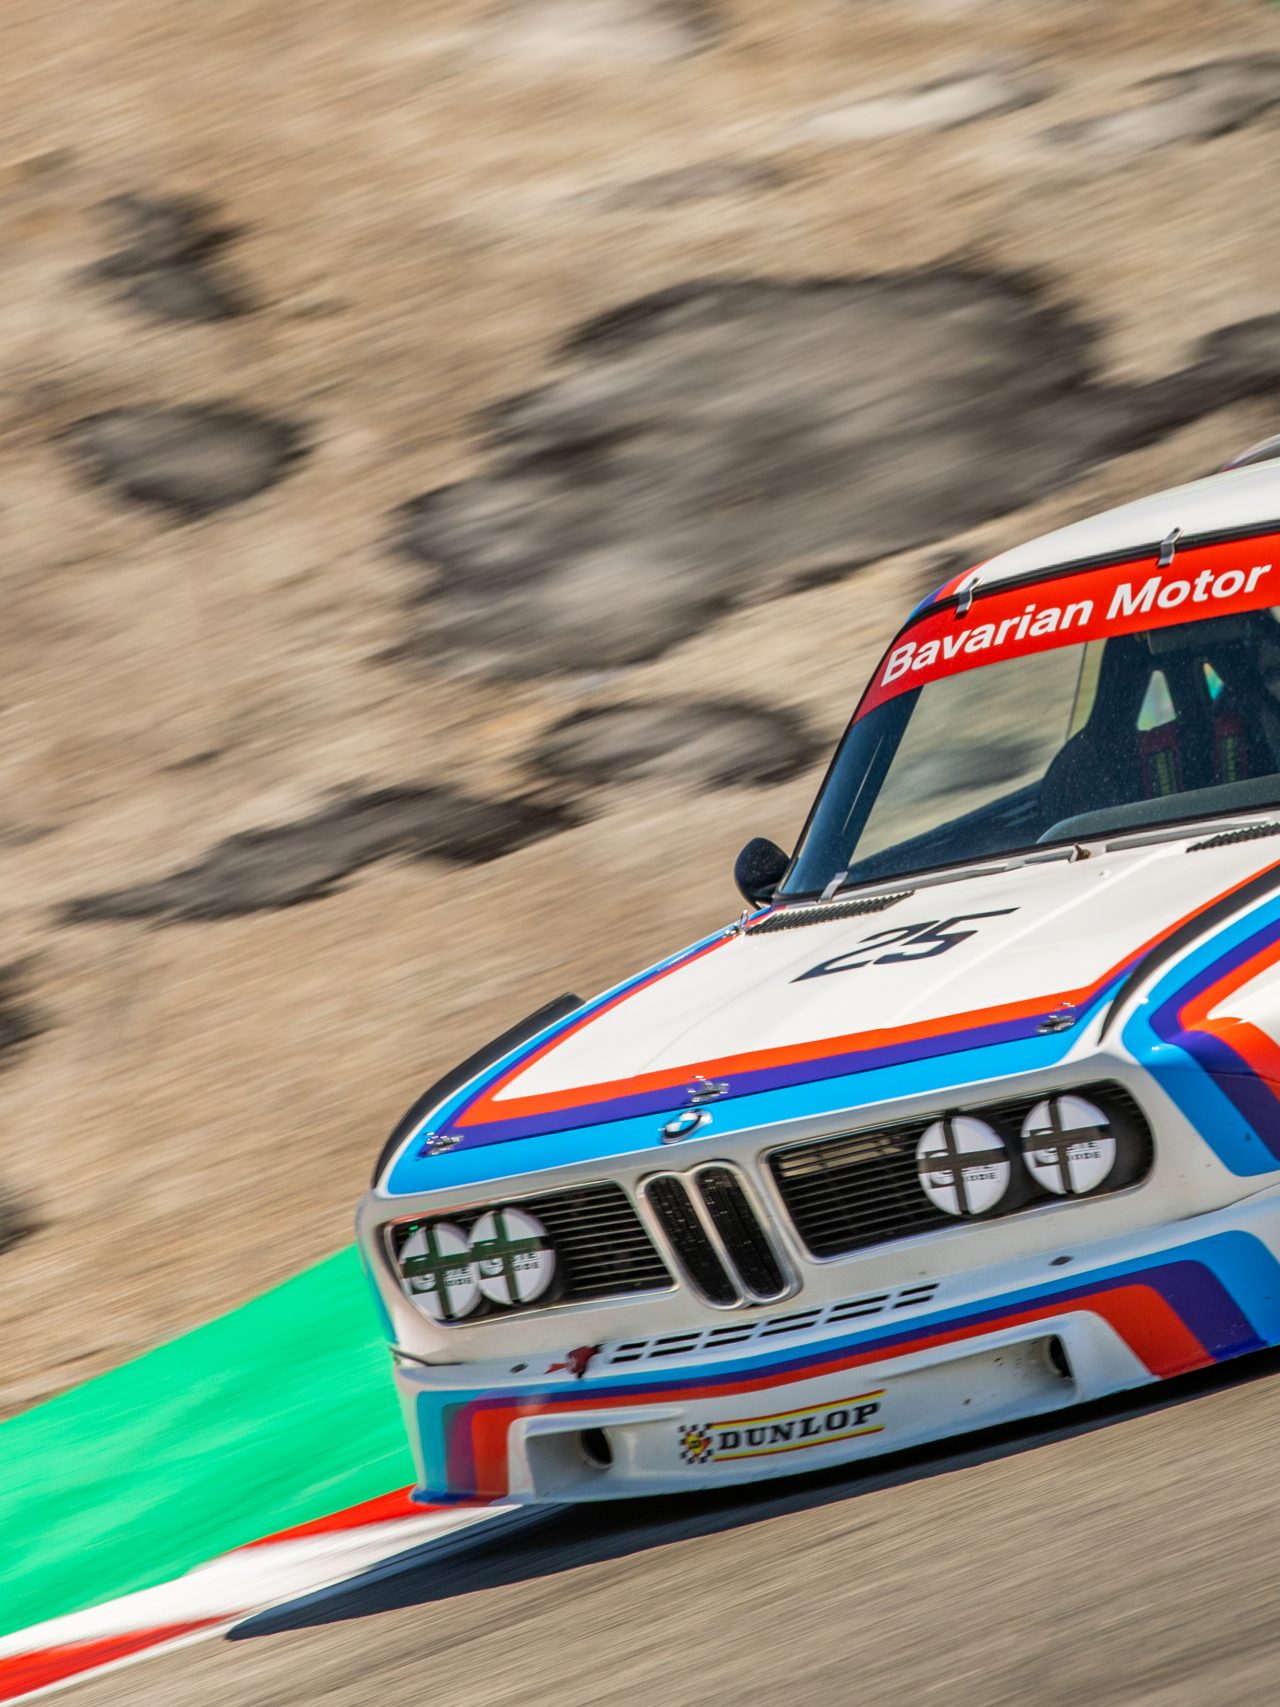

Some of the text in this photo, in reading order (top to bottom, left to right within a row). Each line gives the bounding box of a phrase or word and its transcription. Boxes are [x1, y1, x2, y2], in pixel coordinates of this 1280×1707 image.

[881, 600, 1093, 687] Bavarian
[1106, 564, 1272, 621] Motor
[788, 907, 1021, 984] 25
[716, 1401, 881, 1451] DUNLOP
